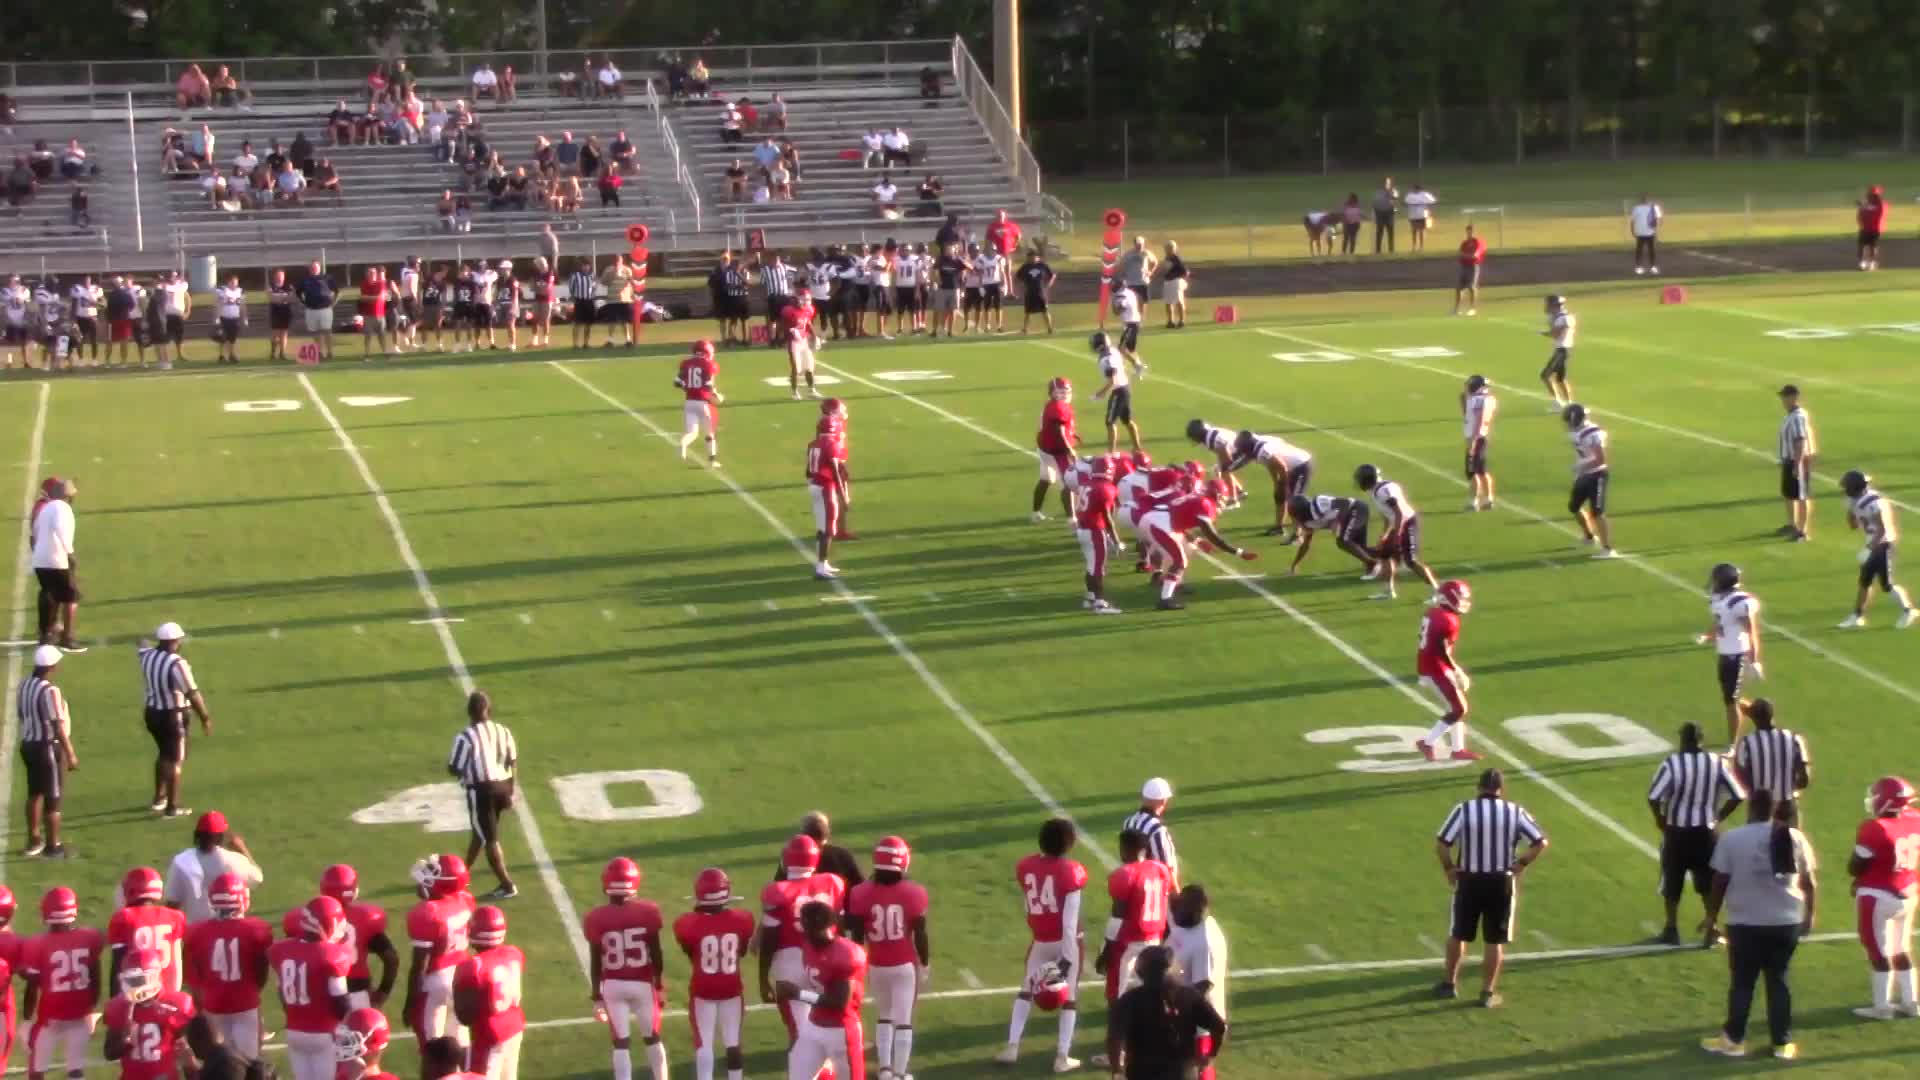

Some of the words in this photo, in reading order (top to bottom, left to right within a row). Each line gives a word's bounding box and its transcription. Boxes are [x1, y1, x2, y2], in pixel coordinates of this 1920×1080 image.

[299, 345, 316, 360] 40
[687, 367, 702, 388] 16
[1024, 873, 1058, 915] 24
[1142, 878, 1163, 921] 11
[868, 904, 904, 941] 30
[211, 937, 241, 981] 41
[601, 927, 648, 970] 85
[701, 933, 739, 974] 88
[50, 948, 90, 992] 25
[280, 959, 311, 1005] 81
